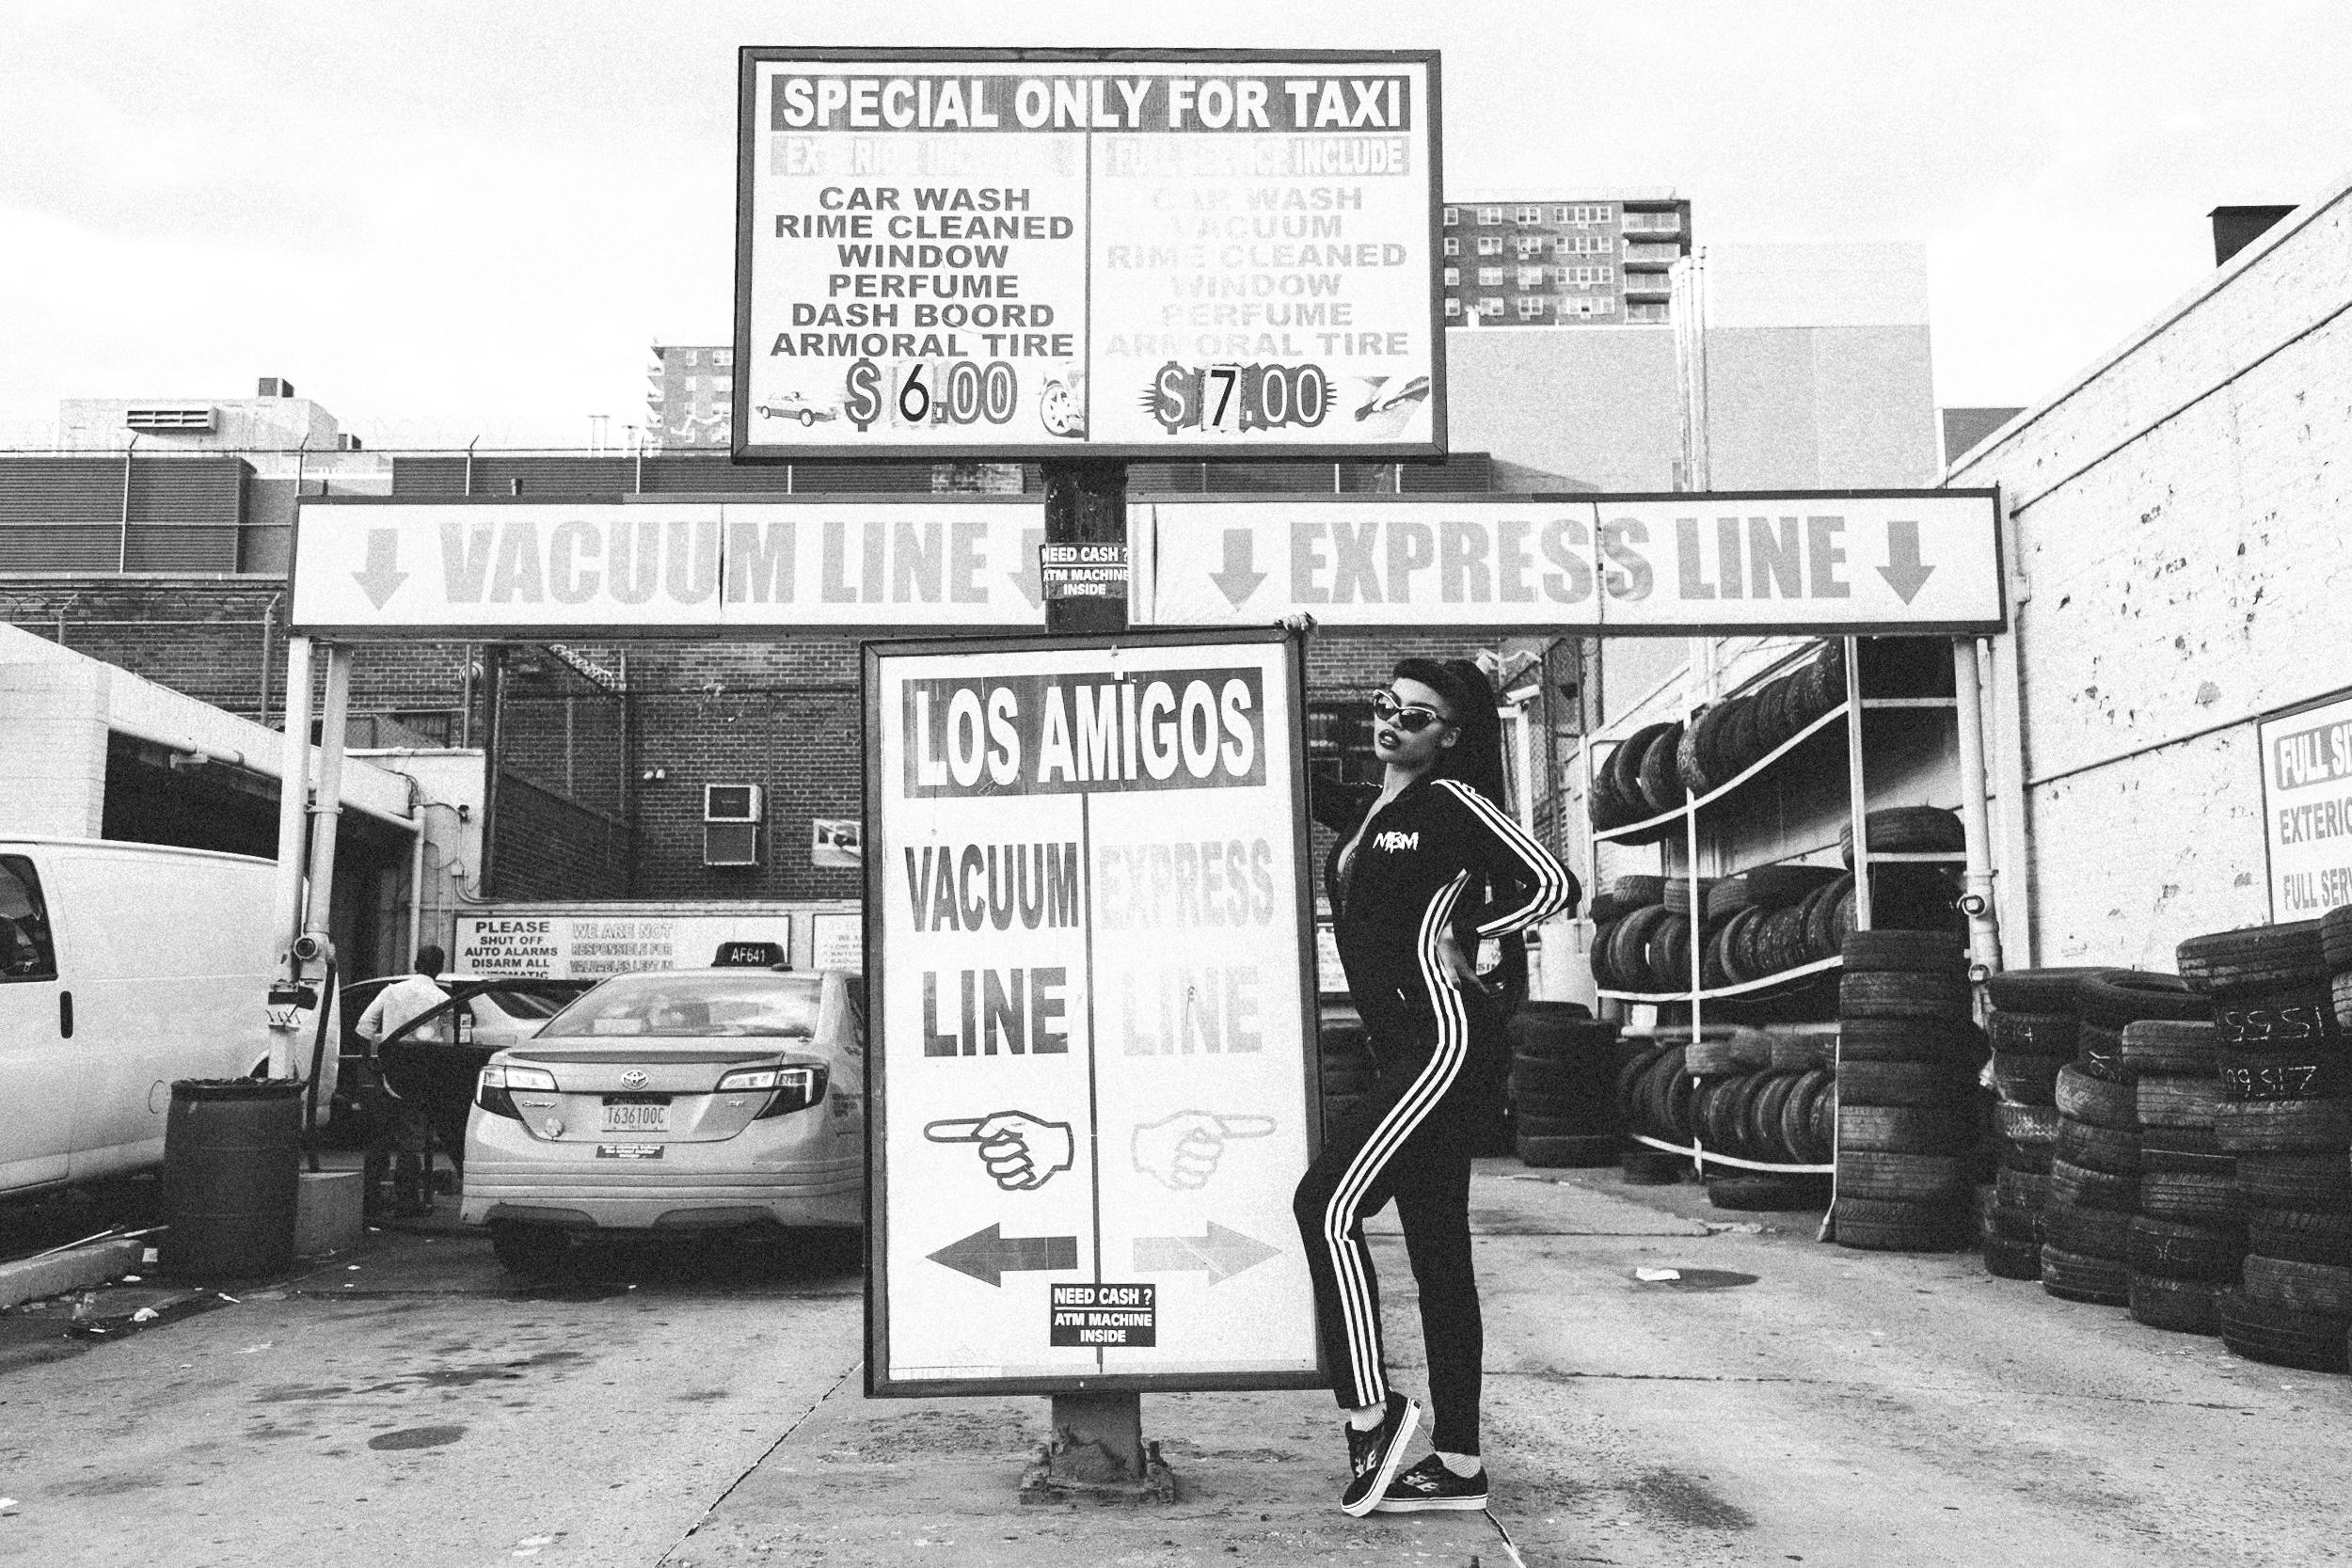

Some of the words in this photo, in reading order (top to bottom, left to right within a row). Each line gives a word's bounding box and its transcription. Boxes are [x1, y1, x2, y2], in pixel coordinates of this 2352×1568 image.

[783, 78, 998, 128] SPECIAL
[1015, 78, 1152, 128] ONLY
[1168, 79, 1270, 128] FOR
[1284, 79, 1401, 128] TAXI
[1294, 138, 1403, 174] INCLUDE
[819, 187, 899, 211] CAR
[914, 188, 1030, 212] WASH
[1248, 187, 1362, 211] WASH
[774, 215, 873, 239] RIME
[888, 216, 1073, 240] CLEANED
[837, 245, 1009, 269] WINDOW
[1219, 244, 1407, 268] CLEANED
[829, 274, 1019, 298] PERFUME
[792, 303, 898, 326] DASH
[914, 304, 1055, 327] BOORD
[1161, 303, 1354, 326] PERFUME
[770, 333, 968, 357] ARMORAL
[981, 334, 1073, 356] TIRE
[1315, 332, 1409, 356] TIRE
[439, 520, 795, 604] VACUUM
[821, 521, 989, 604] LINE
[1041, 546, 1078, 562] NEED
[1080, 546, 1119, 562] CASH
[1290, 517, 1654, 605] EXPRESS
[1676, 515, 1851, 602] LINE
[1043, 568, 1069, 581] ATM
[1071, 568, 1129, 581] MACHINE
[1063, 583, 1106, 595] INSIDE
[915, 687, 1022, 787] LOS
[1038, 677, 1255, 784] AMIGOS
[2279, 731, 2329, 787] FULL
[905, 842, 1079, 933] VACUUM
[1099, 837, 1276, 931] EXPRESS
[2283, 871, 2318, 911] FULL
[475, 921, 551, 933] PLEASE
[601, 923, 634, 939] ARE
[638, 923, 674, 939] NOT
[465, 946, 501, 957] AUTO
[504, 946, 558, 957] ALARMS
[480, 936, 515, 945] SHUT
[519, 936, 545, 945] OFF
[471, 958, 522, 968] DISARM
[526, 958, 550, 968] ALL
[731, 947, 767, 963] AF641
[922, 967, 1069, 1057] LINE
[1123, 964, 1263, 1056] LINE
[608, 1106, 665, 1124] T636100C
[1054, 1288, 1095, 1305] NEED
[1098, 1288, 1140, 1305] CASH
[1143, 1288, 1153, 1306] ?
[1054, 1312, 1086, 1326] ATM
[1089, 1313, 1152, 1327] MACHINE
[1080, 1329, 1127, 1343] INSIDE
